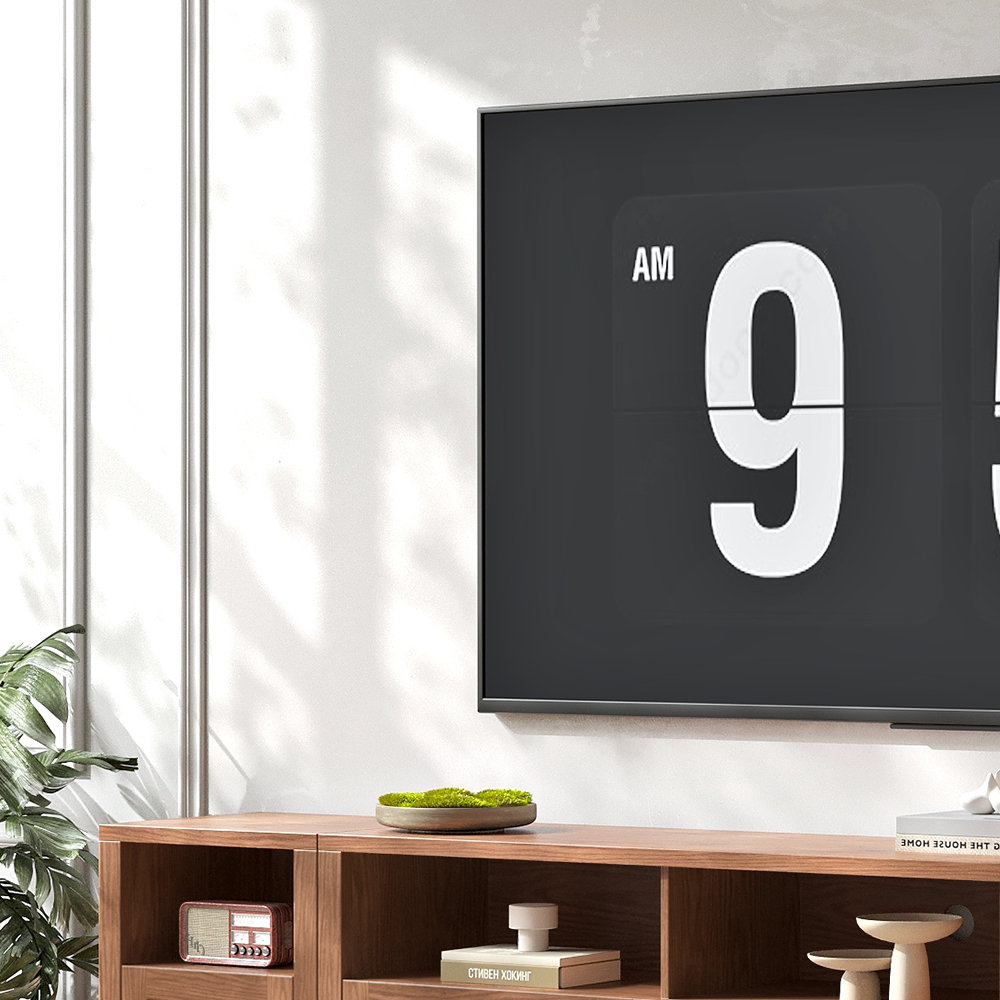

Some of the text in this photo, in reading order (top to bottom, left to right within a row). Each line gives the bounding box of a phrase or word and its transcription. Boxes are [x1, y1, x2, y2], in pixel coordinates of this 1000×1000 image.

[632, 245, 674, 282] AM
[705, 241, 845, 579] 9
[468, 967, 532, 982] СТИВЕН ХОКИНГ
